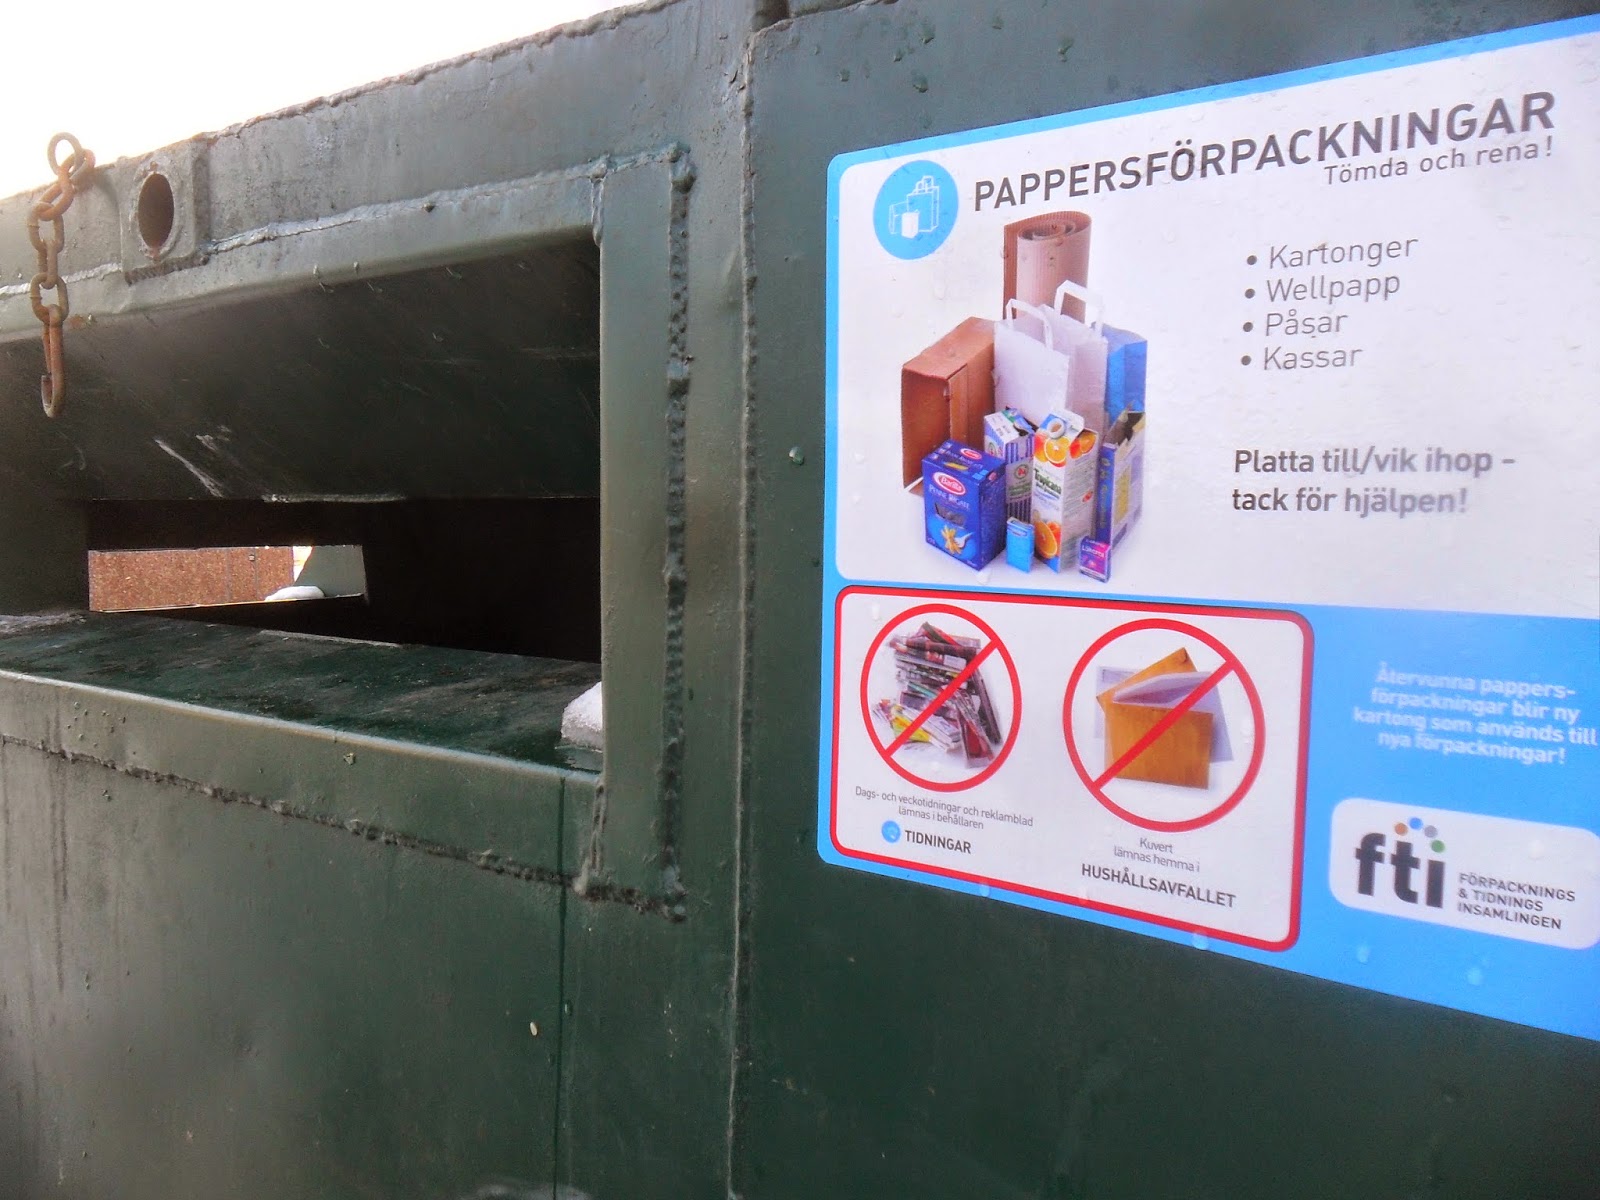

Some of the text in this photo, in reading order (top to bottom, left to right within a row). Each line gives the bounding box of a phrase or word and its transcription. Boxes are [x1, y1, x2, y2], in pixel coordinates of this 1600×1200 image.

[974, 91, 1556, 212] PAPPERSFÖRPACKNINGAR
[1324, 135, 1554, 186] Tömda och rena!
[1269, 238, 1418, 269] Kartonger
[1266, 275, 1400, 304] Wellpapp
[1265, 308, 1348, 336] Påsar
[1263, 346, 1363, 370] Kassar
[1234, 449, 1314, 473] Platta
[1323, 446, 1418, 475] till/vik
[1425, 447, 1493, 478] ihop
[1232, 487, 1468, 518] tack för hjälpen!
[1376, 660, 1576, 699] Återvunna pappers-
[1371, 687, 1581, 725] förpackningar blir ny
[1353, 706, 1598, 746] kartong som används till
[1378, 732, 1566, 766] nya förpackningar!
[855, 786, 1034, 827] Dags- och veckotidningar och reklamblad
[898, 805, 931, 820] lämnas
[937, 812, 984, 830] behållaren
[904, 829, 972, 855] TIDNINGAR
[1139, 837, 1173, 854] Kuvert
[1113, 845, 1151, 863] lämnas
[1153, 853, 1195, 873] hemma
[1355, 832, 1446, 909] fti
[1081, 863, 1237, 908] HUSHÅLLSAVFALLET
[1457, 887, 1544, 912] & TIDNINGS
[1458, 872, 1576, 903] FÖRPACKNINGS
[1457, 902, 1562, 930] INSAMLINGEN
